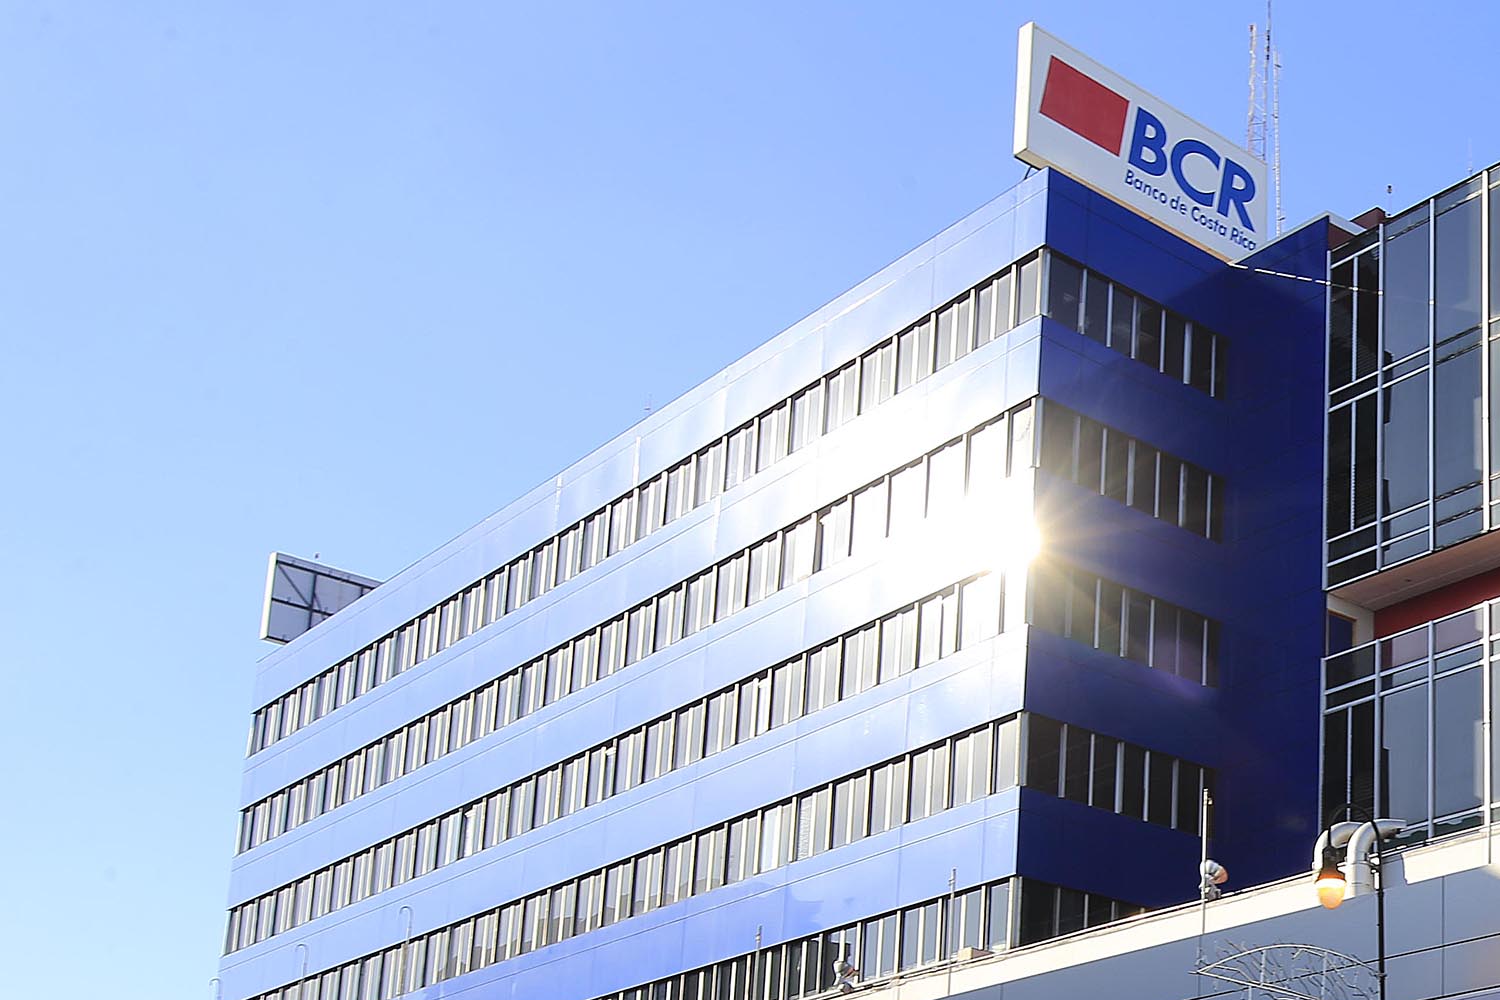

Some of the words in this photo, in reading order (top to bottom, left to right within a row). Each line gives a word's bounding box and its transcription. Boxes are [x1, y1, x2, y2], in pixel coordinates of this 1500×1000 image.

[1124, 169, 1167, 204] Banco
[1171, 194, 1187, 216] de
[1191, 208, 1227, 238] Costa
[1230, 224, 1256, 251] Rica
[1128, 106, 1256, 233] BCR
